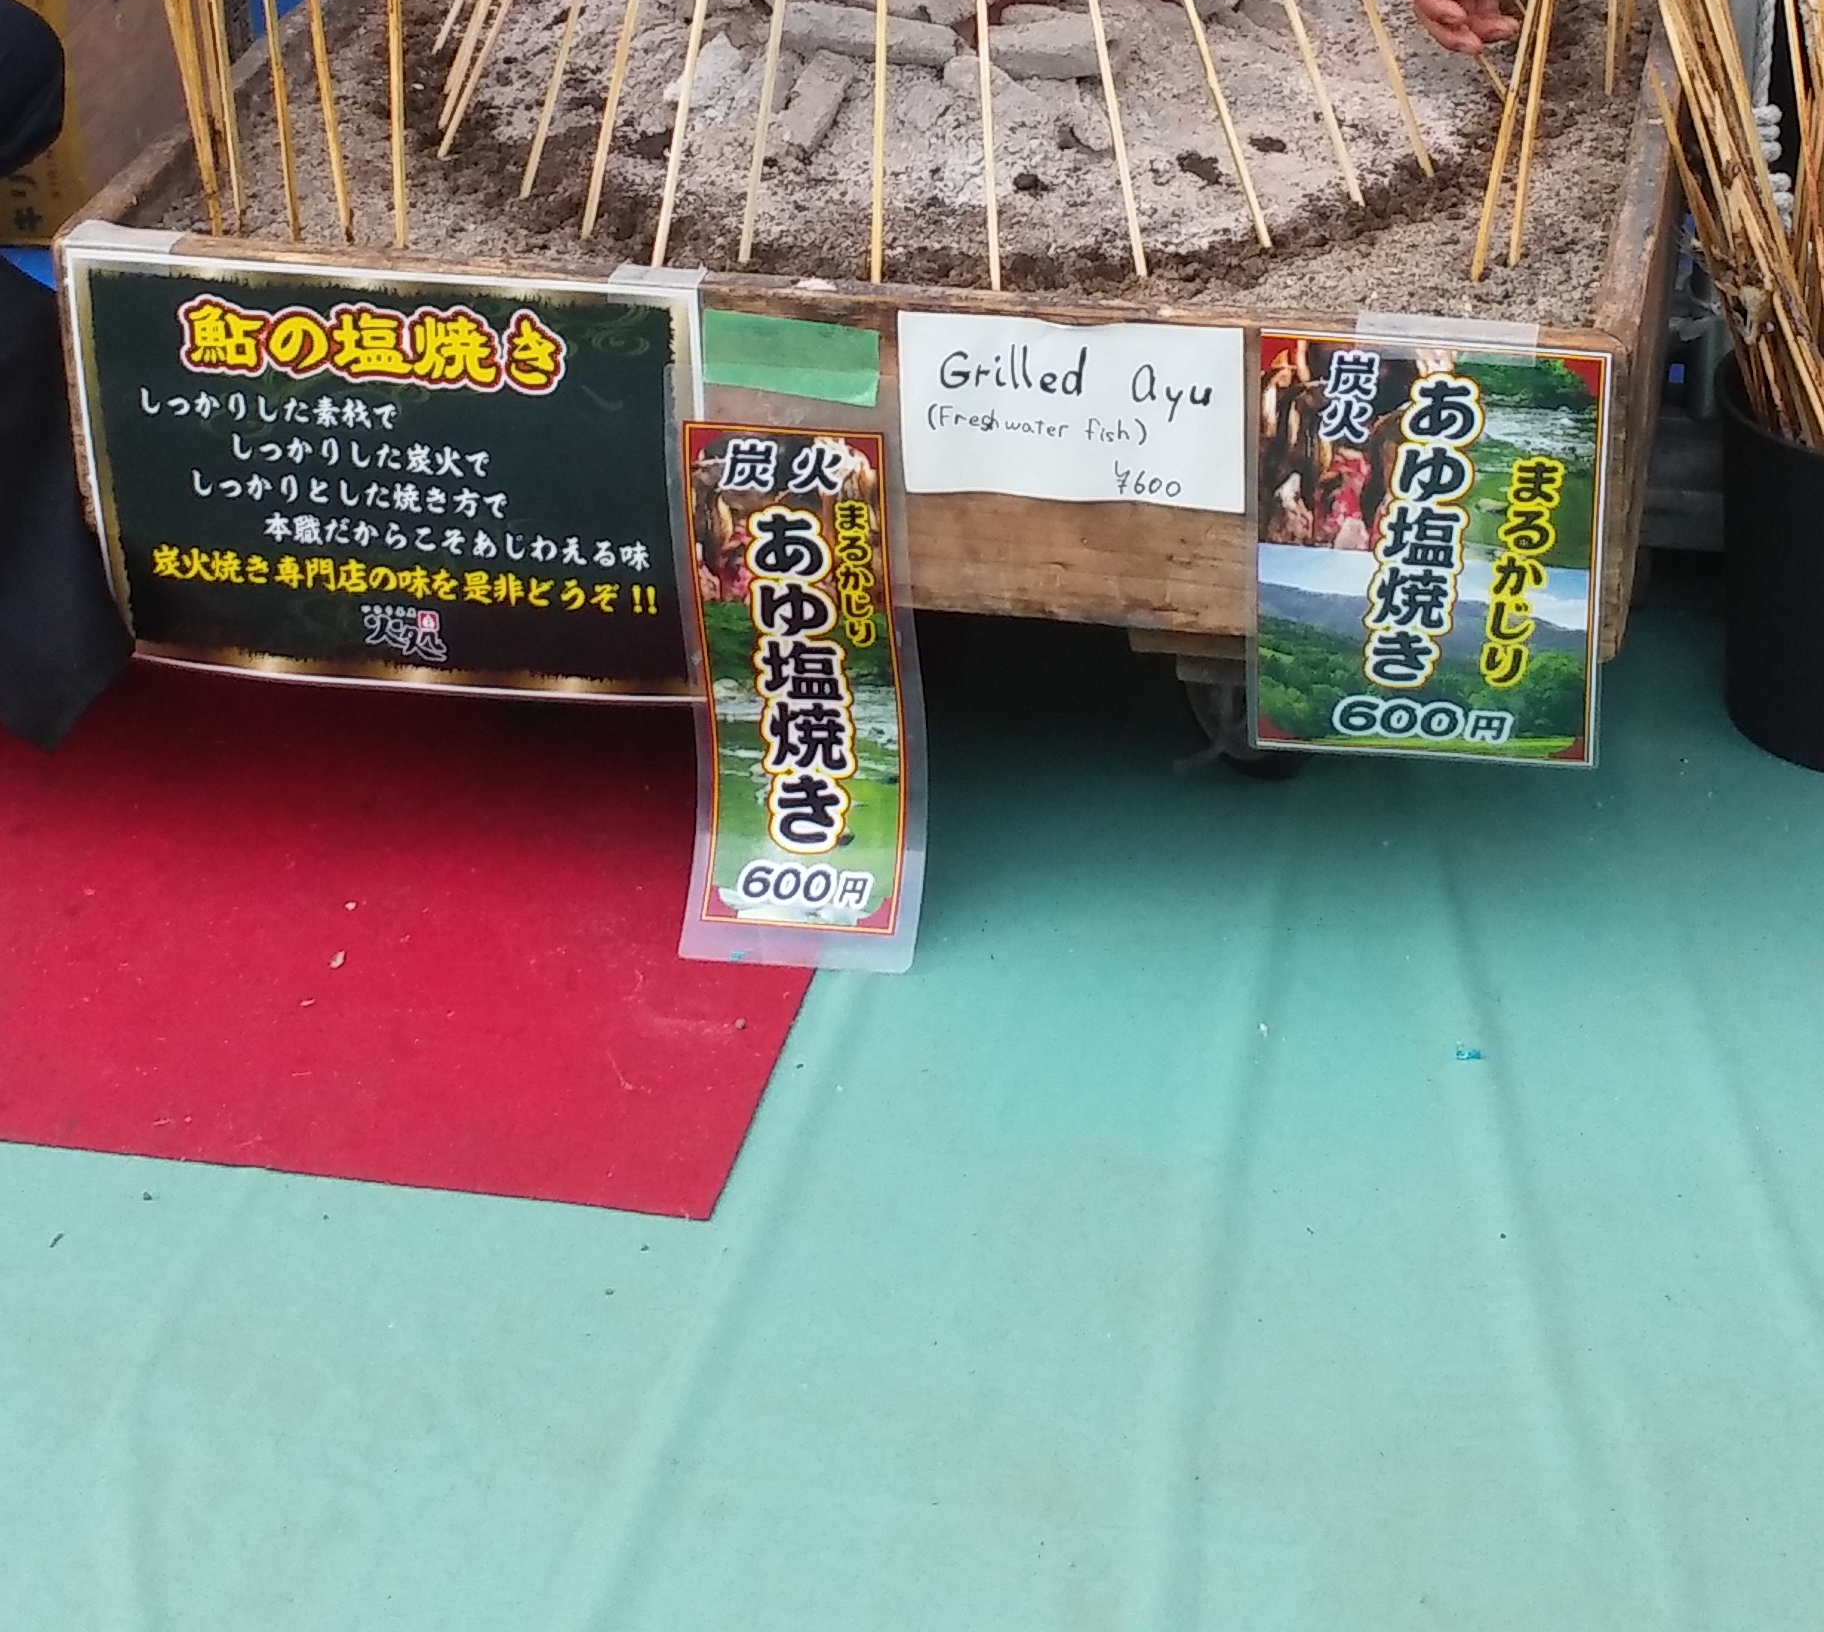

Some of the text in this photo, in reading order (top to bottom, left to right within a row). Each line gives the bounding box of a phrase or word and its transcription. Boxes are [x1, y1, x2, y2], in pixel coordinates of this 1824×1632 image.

[181, 296, 565, 393] 鮎の塩焼き
[940, 343, 1088, 397] Grilled
[1319, 350, 1379, 443] 炭火
[231, 432, 491, 478] しっかりした炭火で
[719, 440, 845, 495] 炭火
[1113, 460, 1182, 498] ¥600
[191, 468, 509, 519] しっかりとした焼き方で
[263, 511, 651, 573] 本職だからこそあじわえる味
[1366, 376, 1480, 685] あゆ塩焼き
[833, 502, 878, 647] まるかじり
[1482, 459, 1565, 686] まるかじり
[751, 509, 849, 850] あゆ塩焼き
[1333, 697, 1513, 745] 600円
[740, 863, 874, 908] 600円
